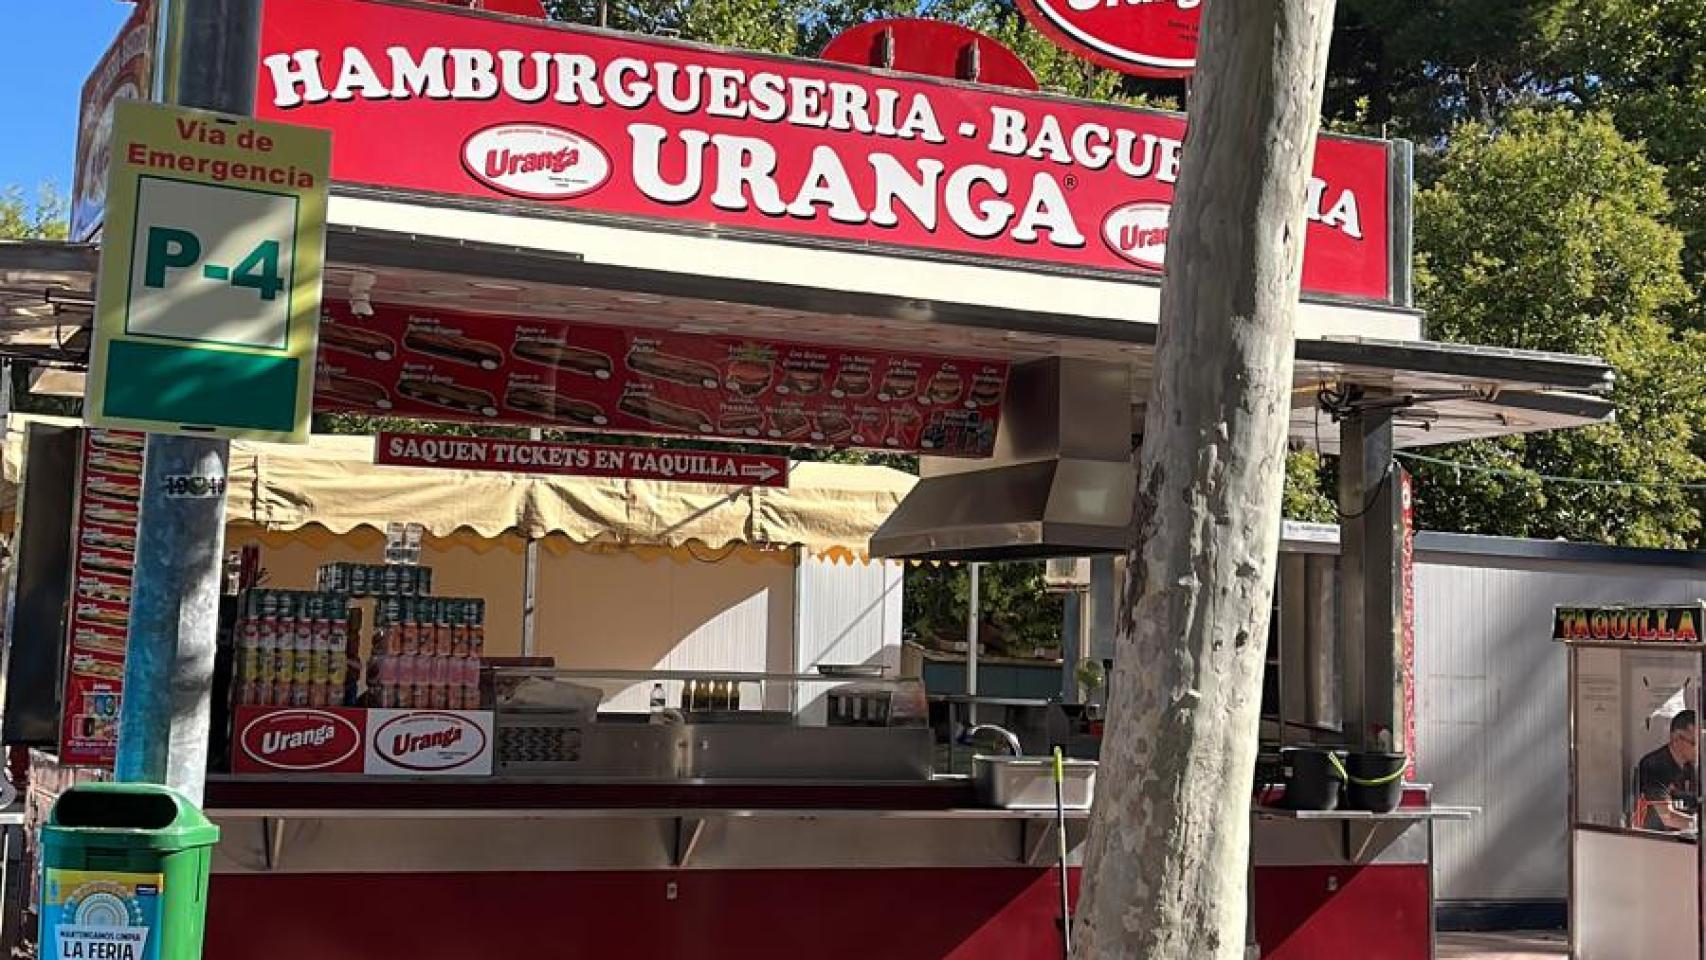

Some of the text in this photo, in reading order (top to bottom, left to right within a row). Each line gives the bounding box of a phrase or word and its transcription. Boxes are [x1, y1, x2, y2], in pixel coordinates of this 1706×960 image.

[262, 46, 946, 144] HAMBURGUESERIA
[235, 129, 275, 152] de
[126, 143, 315, 189] Emergencia
[485, 145, 579, 178] Uranga
[144, 226, 285, 301] P-4
[389, 437, 738, 477] SAQUEN TICKETS EN TAQUILLA
[1560, 609, 1697, 641] TAQUILLA
[262, 724, 335, 755] Uranga
[392, 726, 463, 756] Uranga
[64, 941, 134, 960] LA FERIA
